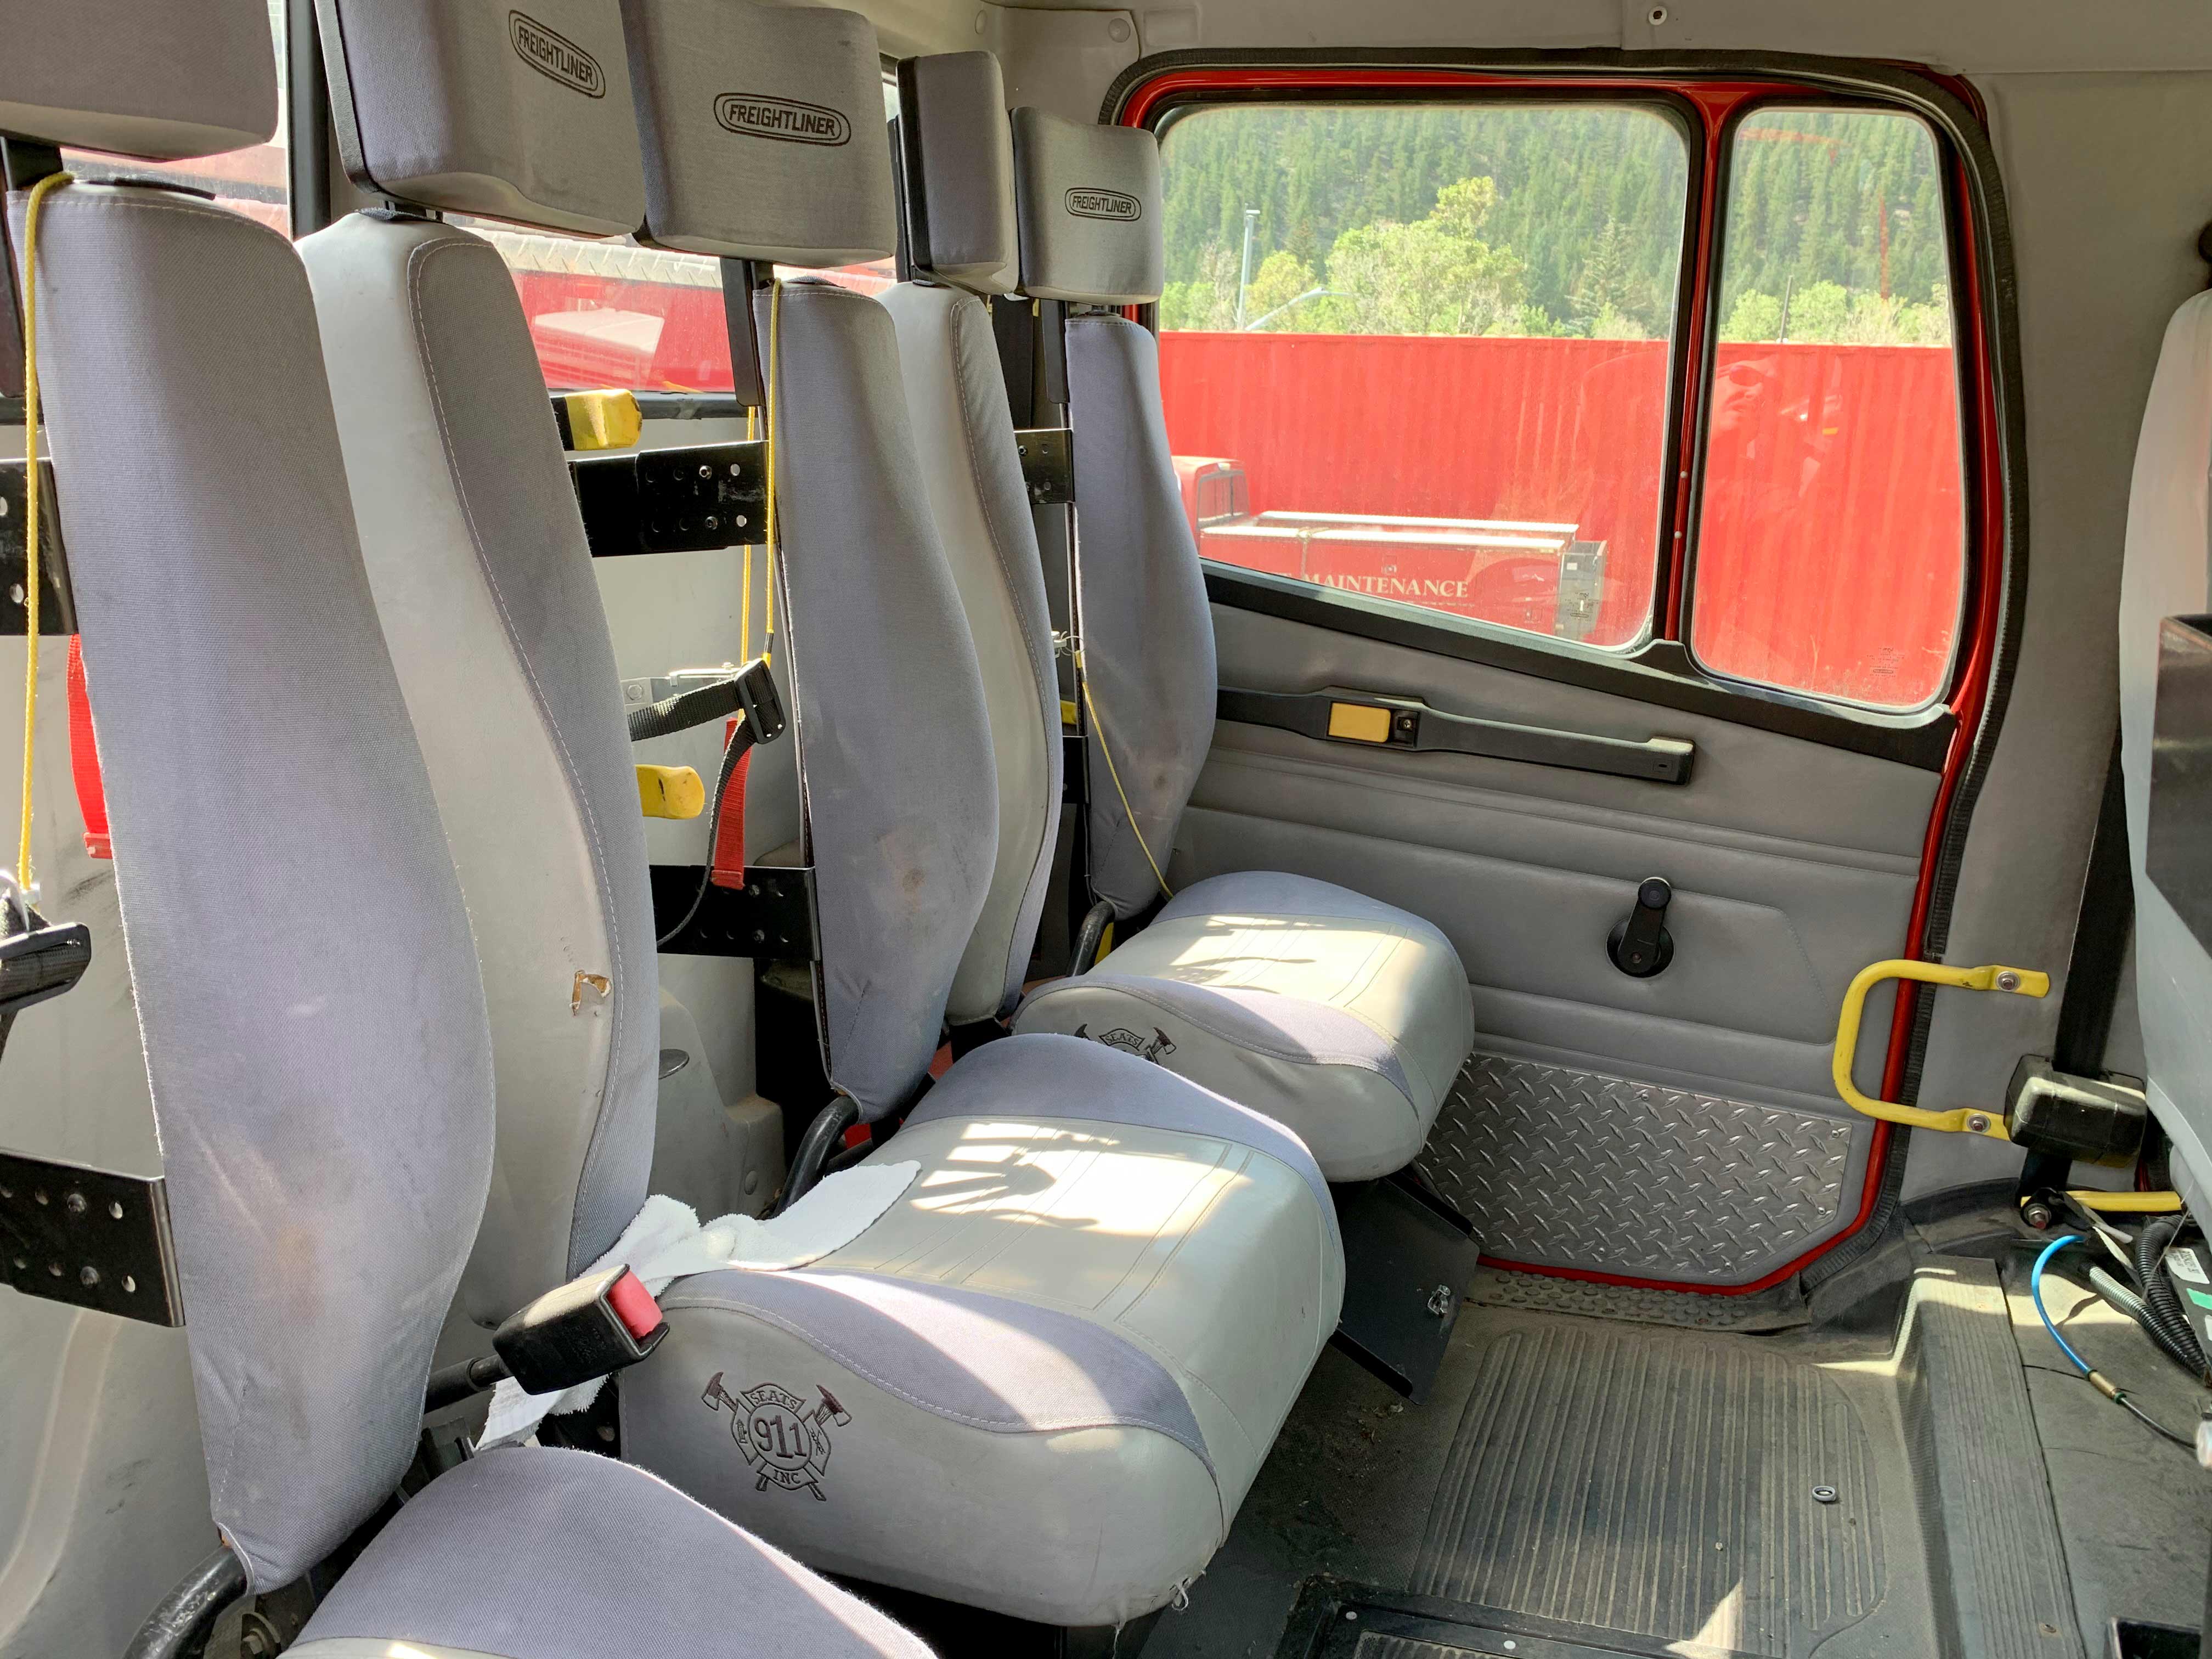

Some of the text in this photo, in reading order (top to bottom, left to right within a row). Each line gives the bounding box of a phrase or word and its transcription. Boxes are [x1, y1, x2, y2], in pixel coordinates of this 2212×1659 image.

[518, 25, 593, 84] FREIGHTLINER
[729, 103, 836, 137] FREIGHTLINER
[1072, 195, 1132, 215] FREIGHTLINER
[1104, 1032, 1140, 1046] SEATS
[750, 1390, 798, 1410] SEATS
[754, 1414, 807, 1459] 911
[772, 1469, 801, 1485] INC
